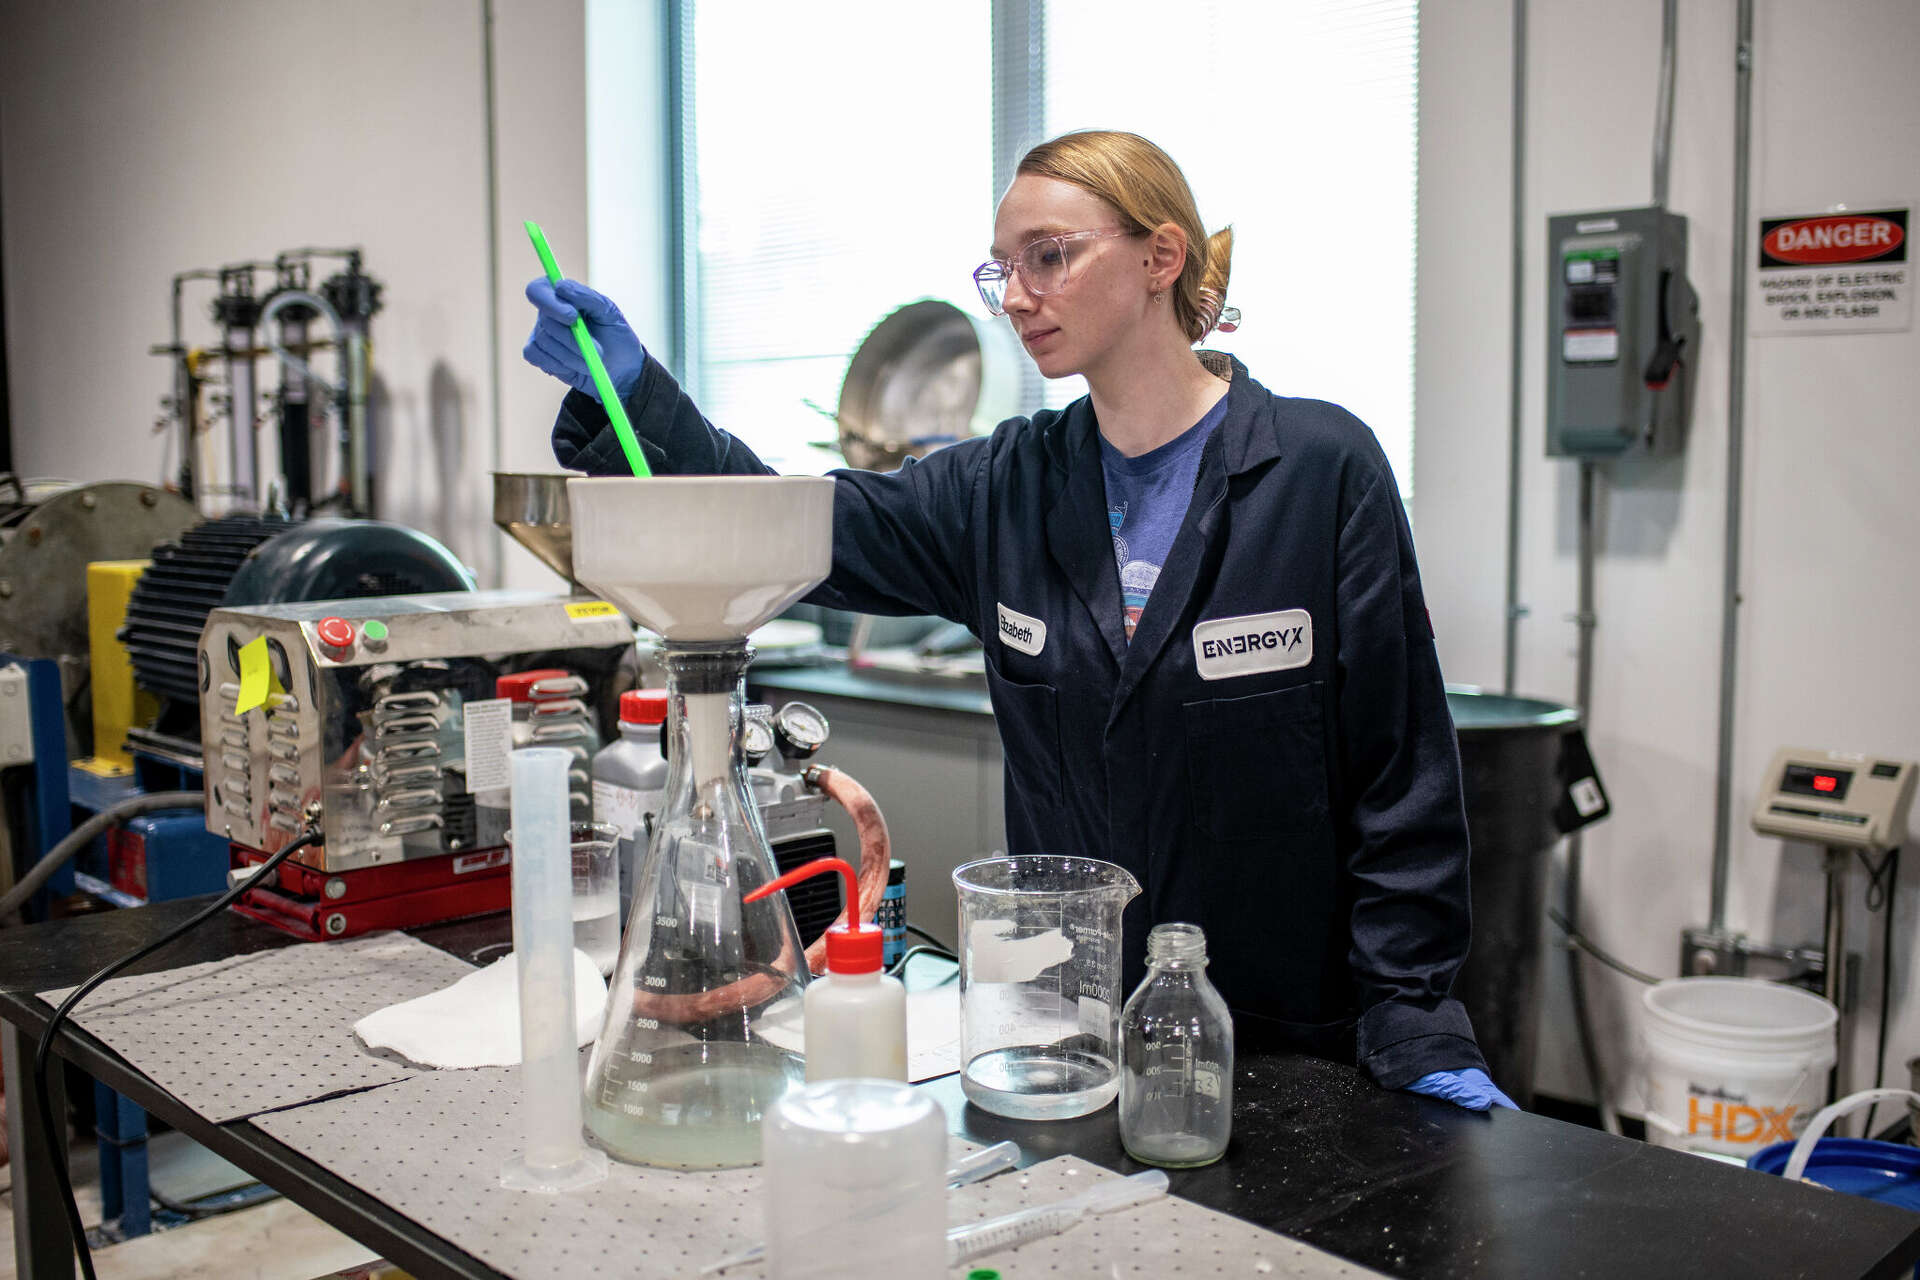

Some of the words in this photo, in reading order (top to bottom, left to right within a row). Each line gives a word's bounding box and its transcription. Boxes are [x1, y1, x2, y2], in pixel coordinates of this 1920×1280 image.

[1776, 221, 1892, 252] DANGER
[1815, 273, 1834, 287] OF
[1837, 271, 1905, 286] ELECTRIC
[1834, 304, 1880, 318] FLASH
[1202, 626, 1304, 660] ENERGYX
[655, 915, 678, 929] 3500
[643, 974, 667, 988] 3000
[636, 1017, 659, 1030] 2500
[630, 1050, 653, 1064] 2000
[627, 1079, 648, 1093] 1500
[623, 1103, 645, 1116] 1000
[1688, 1096, 1798, 1145] HDX
